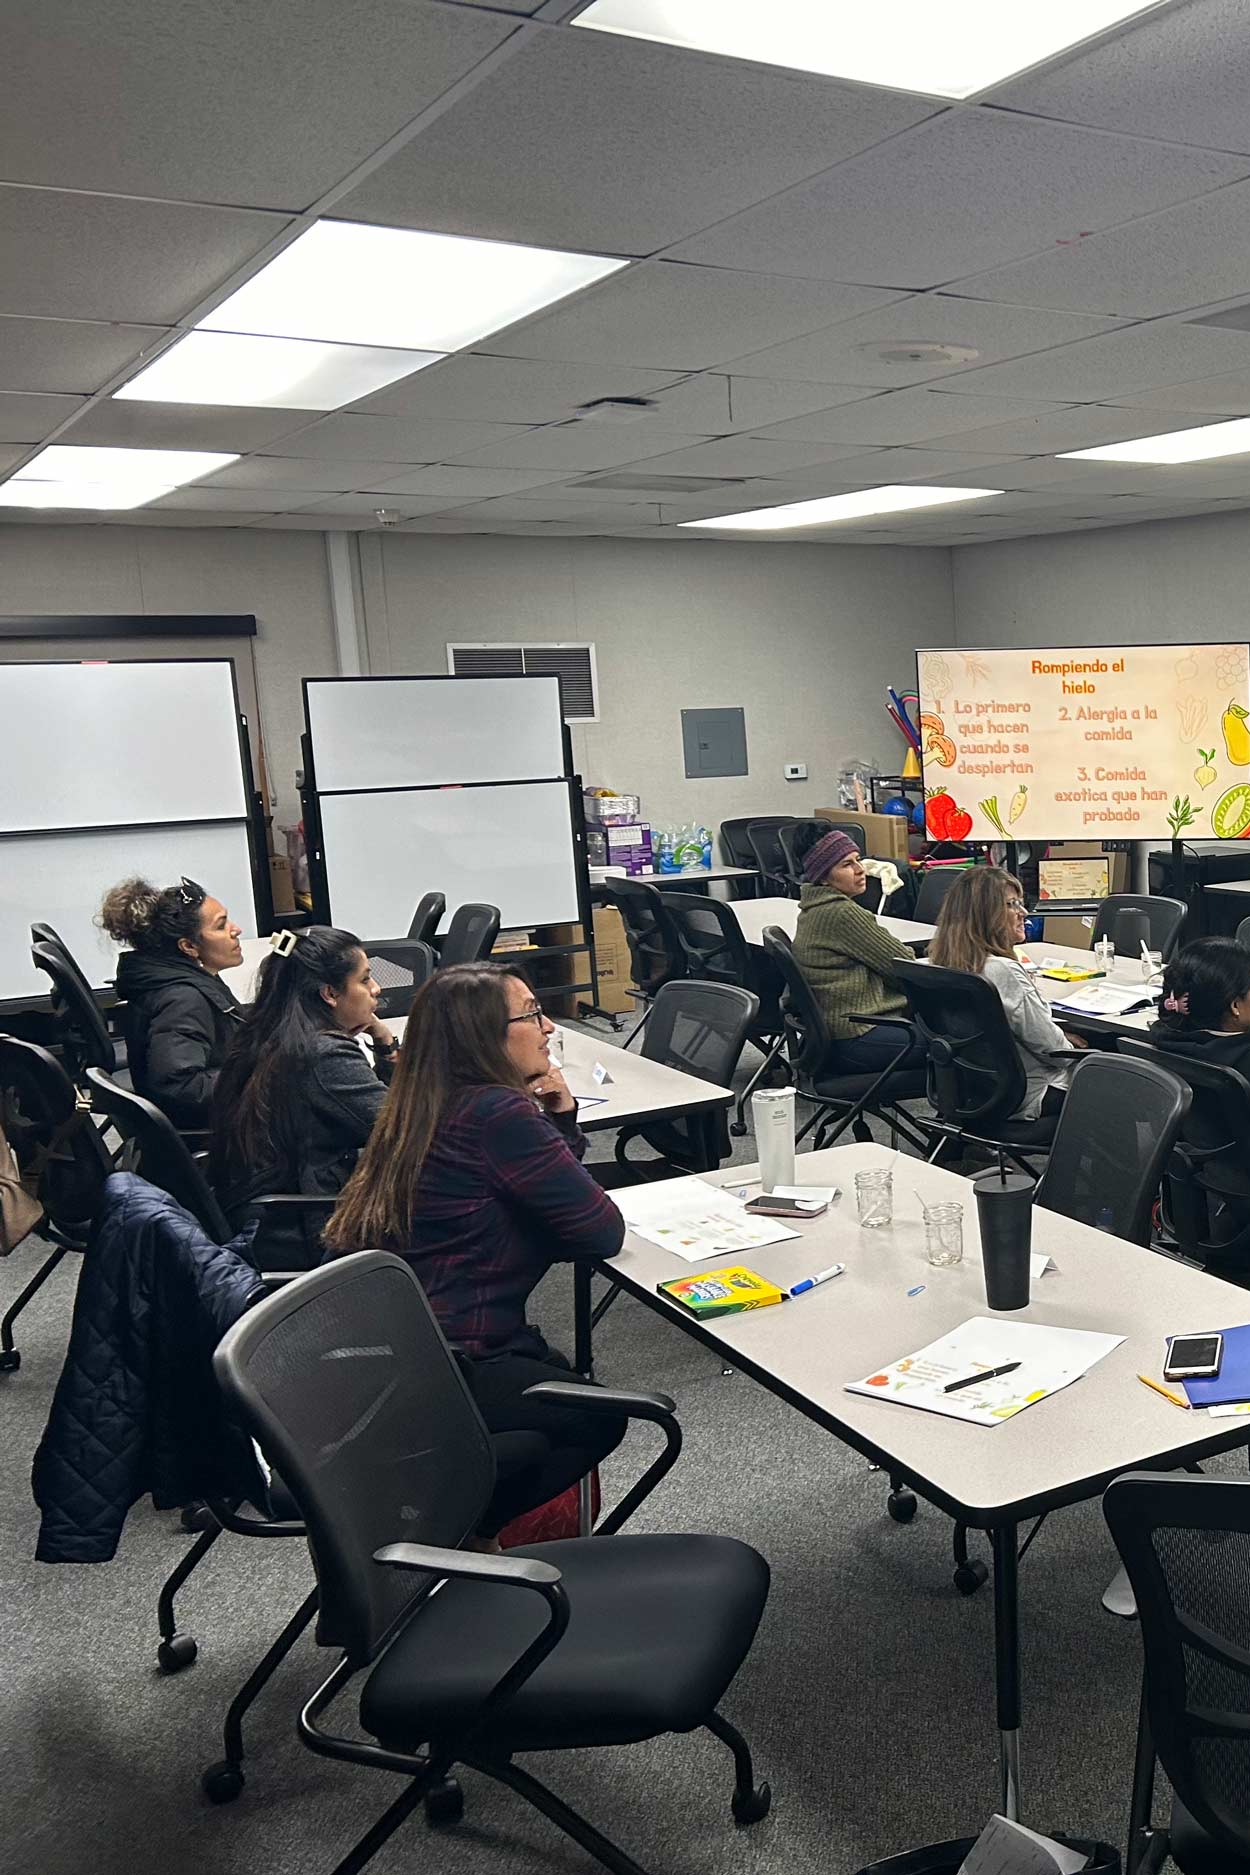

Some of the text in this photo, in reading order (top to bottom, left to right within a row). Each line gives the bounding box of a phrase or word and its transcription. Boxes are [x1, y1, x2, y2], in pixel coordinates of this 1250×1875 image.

[1031, 658, 1125, 677] Rompiendo el
[1062, 680, 1096, 694] hielo
[934, 699, 1031, 717] 1. Lo primero
[1058, 704, 1158, 723] 2. Alergia a la
[959, 719, 1030, 738] que hacen
[1084, 726, 1133, 741] comida
[959, 739, 1030, 755] cuando se
[957, 759, 1034, 778] despiertan
[1076, 766, 1147, 781] 3. Comida
[1054, 786, 1168, 804] exotica que han
[1082, 807, 1141, 825] probado
